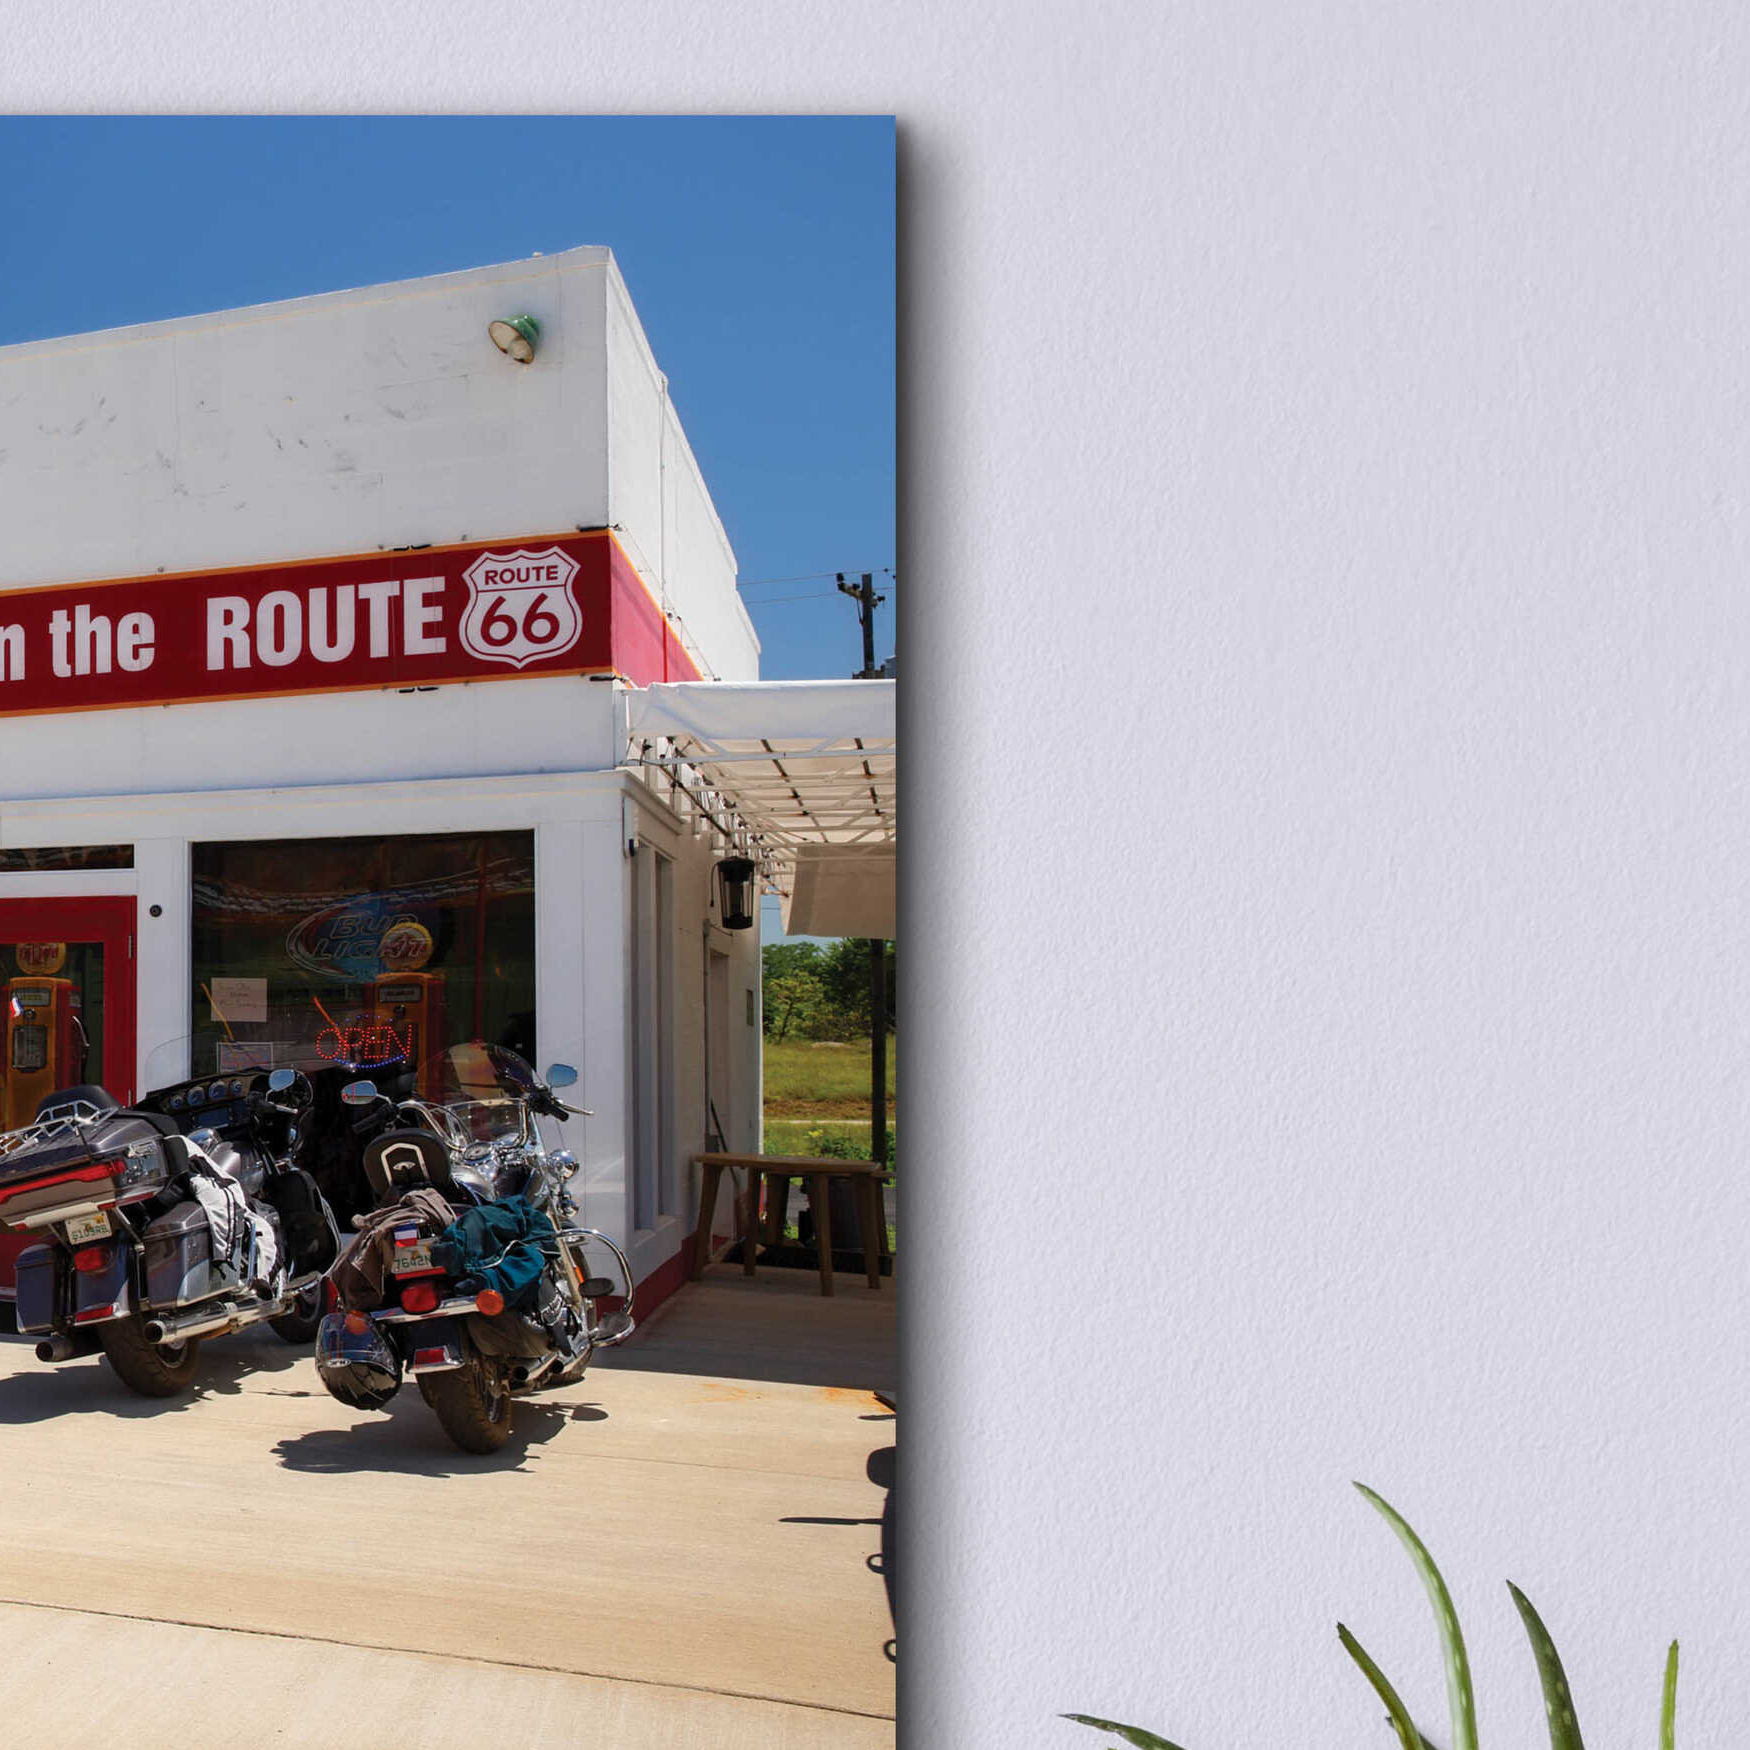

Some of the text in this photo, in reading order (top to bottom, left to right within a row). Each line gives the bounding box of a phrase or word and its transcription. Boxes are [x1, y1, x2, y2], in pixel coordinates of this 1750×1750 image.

[484, 565, 559, 586] ROUTE
[49, 604, 155, 678] the
[207, 576, 447, 671] ROUTE
[480, 593, 560, 647] 66
[316, 1024, 413, 1060] OPEN
